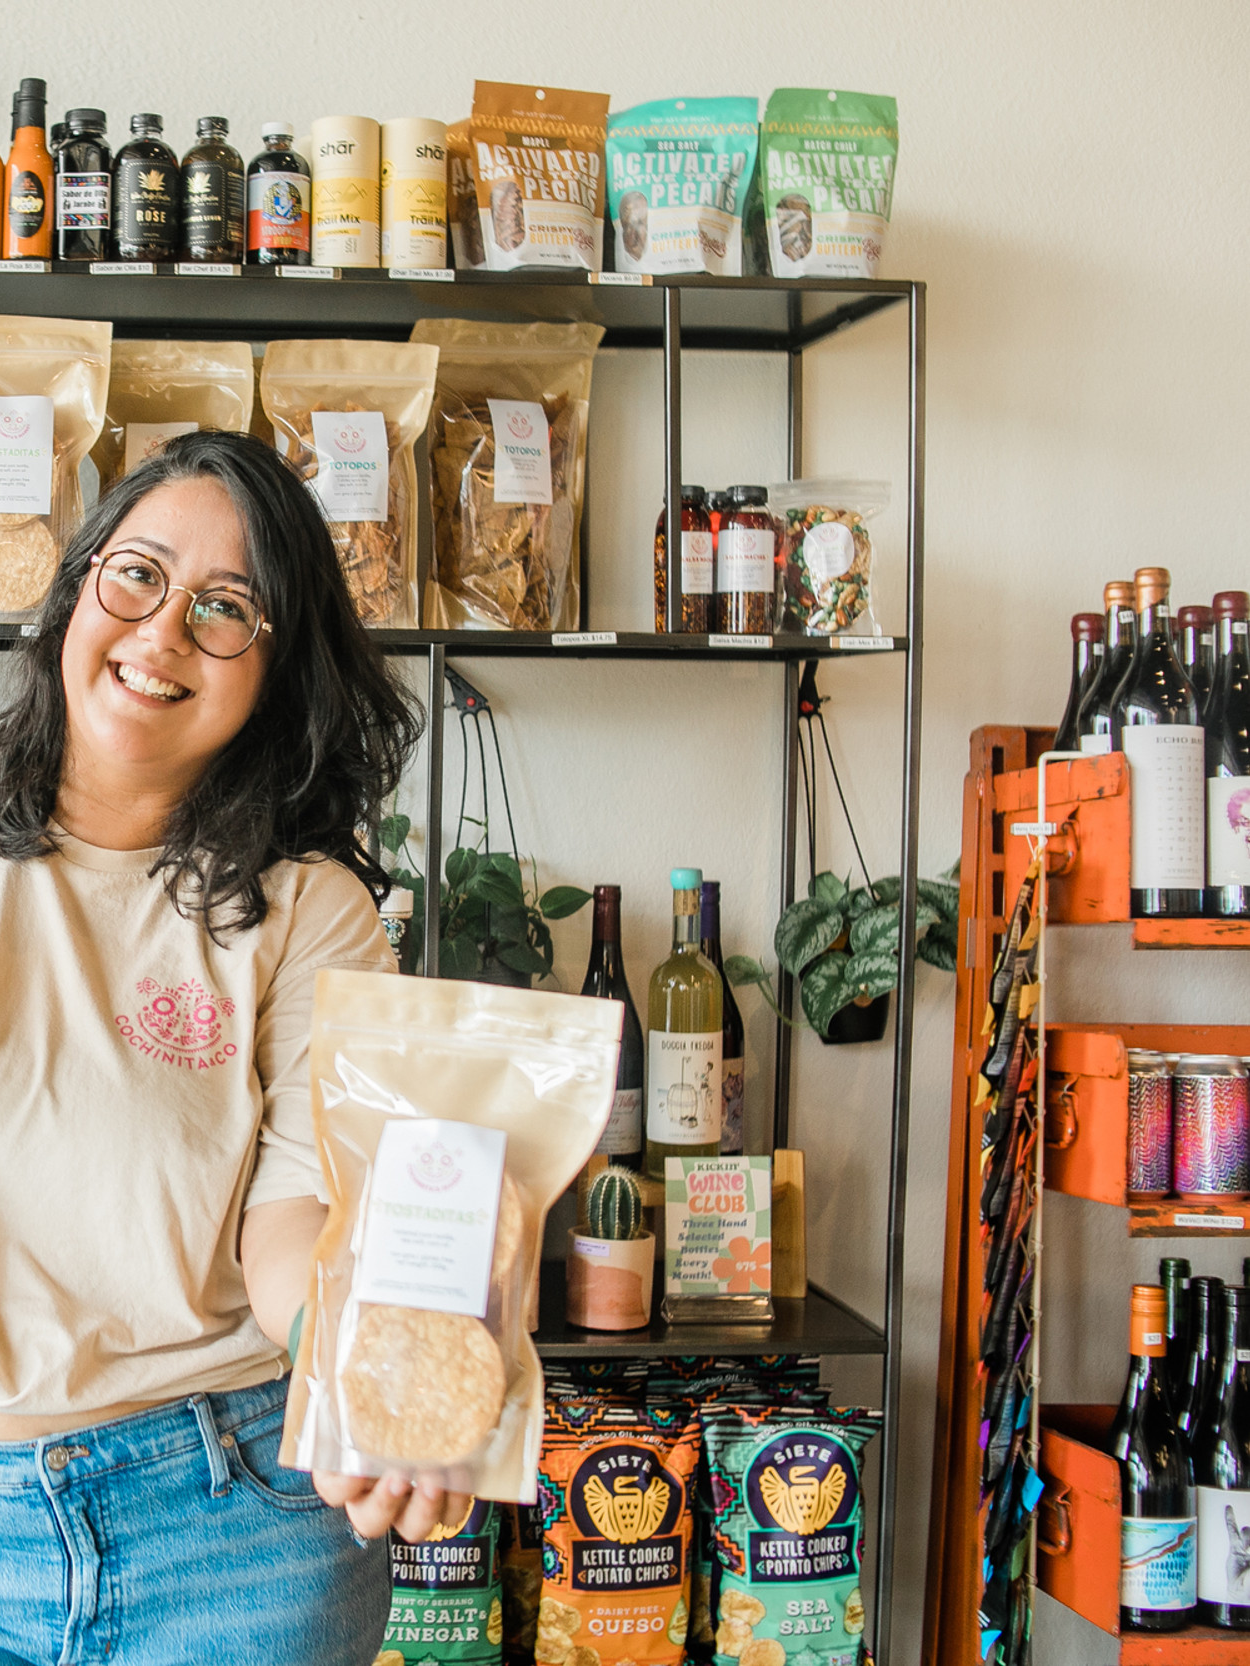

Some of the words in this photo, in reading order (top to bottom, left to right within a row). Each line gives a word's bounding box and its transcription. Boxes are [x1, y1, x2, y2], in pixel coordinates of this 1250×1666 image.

[522, 136, 550, 148] MAPLE
[657, 141, 675, 151] SEA
[677, 141, 700, 151] SALT
[804, 140, 832, 151] HATCH
[476, 142, 600, 178] ACTIVATED
[613, 152, 746, 180] ACTIVATED
[479, 164, 544, 182] NATIVE
[549, 170, 598, 190] TEXAS
[614, 172, 677, 192] NATIVE
[768, 175, 836, 190] NATIVE
[62, 190, 80, 198] Sabor
[95, 189, 108, 197] Olla
[71, 200, 96, 208] Jarabe
[136, 211, 166, 223] ROSE
[339, 214, 361, 224] Mix
[529, 225, 573, 233] CRISPY
[652, 229, 699, 241] CRISPY
[530, 233, 574, 245] BUTTERY
[652, 237, 699, 253] BUTTERY
[816, 235, 863, 243] CRISPY
[816, 244, 863, 256] BUTTERY
[504, 445, 542, 457] TOTOPOS
[329, 461, 377, 470] TOTOPOS
[556, 635, 581, 643] Totopos
[1155, 736, 1188, 744] ECHO
[115, 1015, 209, 1070] COCHINITA
[661, 1041, 686, 1051] DOCCIA
[690, 1040, 714, 1051] FREDDA
[697, 1163, 740, 1171] KICKIN'
[688, 1173, 745, 1194] WINE
[688, 1195, 746, 1214] CLUB
[384, 1202, 475, 1225] TOSTADITAS
[682, 1220, 714, 1228] Three
[718, 1219, 748, 1228] Hand
[678, 1232, 725, 1241] Selected
[681, 1245, 719, 1254] Bottles
[675, 1259, 708, 1268] Every
[736, 1261, 756, 1272] $75
[672, 1272, 711, 1280] Month!
[618, 1430, 636, 1438] OIL
[773, 1444, 832, 1465] SIETE
[598, 1455, 652, 1473] SIETE
[760, 1540, 805, 1558] KETTLE
[808, 1536, 848, 1554] COOKED
[433, 1546, 481, 1563] COOKED
[583, 1548, 625, 1566] KETTLE
[629, 1546, 674, 1564] COOKED
[766, 1558, 811, 1576] POTATO
[813, 1554, 842, 1573] CHIPS
[393, 1565, 435, 1582] POTATO
[440, 1565, 476, 1582] CHIPS
[587, 1567, 632, 1584] POTATO
[635, 1564, 670, 1582] CHIPS
[392, 1597, 416, 1606] HINT
[418, 1598, 429, 1606] OF
[431, 1597, 474, 1606] SERRANO
[786, 1599, 830, 1616] SEA
[389, 1609, 419, 1624] EA
[423, 1608, 477, 1624] SALT
[479, 1611, 487, 1621] &
[597, 1607, 629, 1616] DAIRY
[632, 1606, 658, 1615] FREE
[588, 1618, 665, 1637] QUESO
[779, 1616, 836, 1635] SALT
[384, 1626, 480, 1643] VINEGAR
